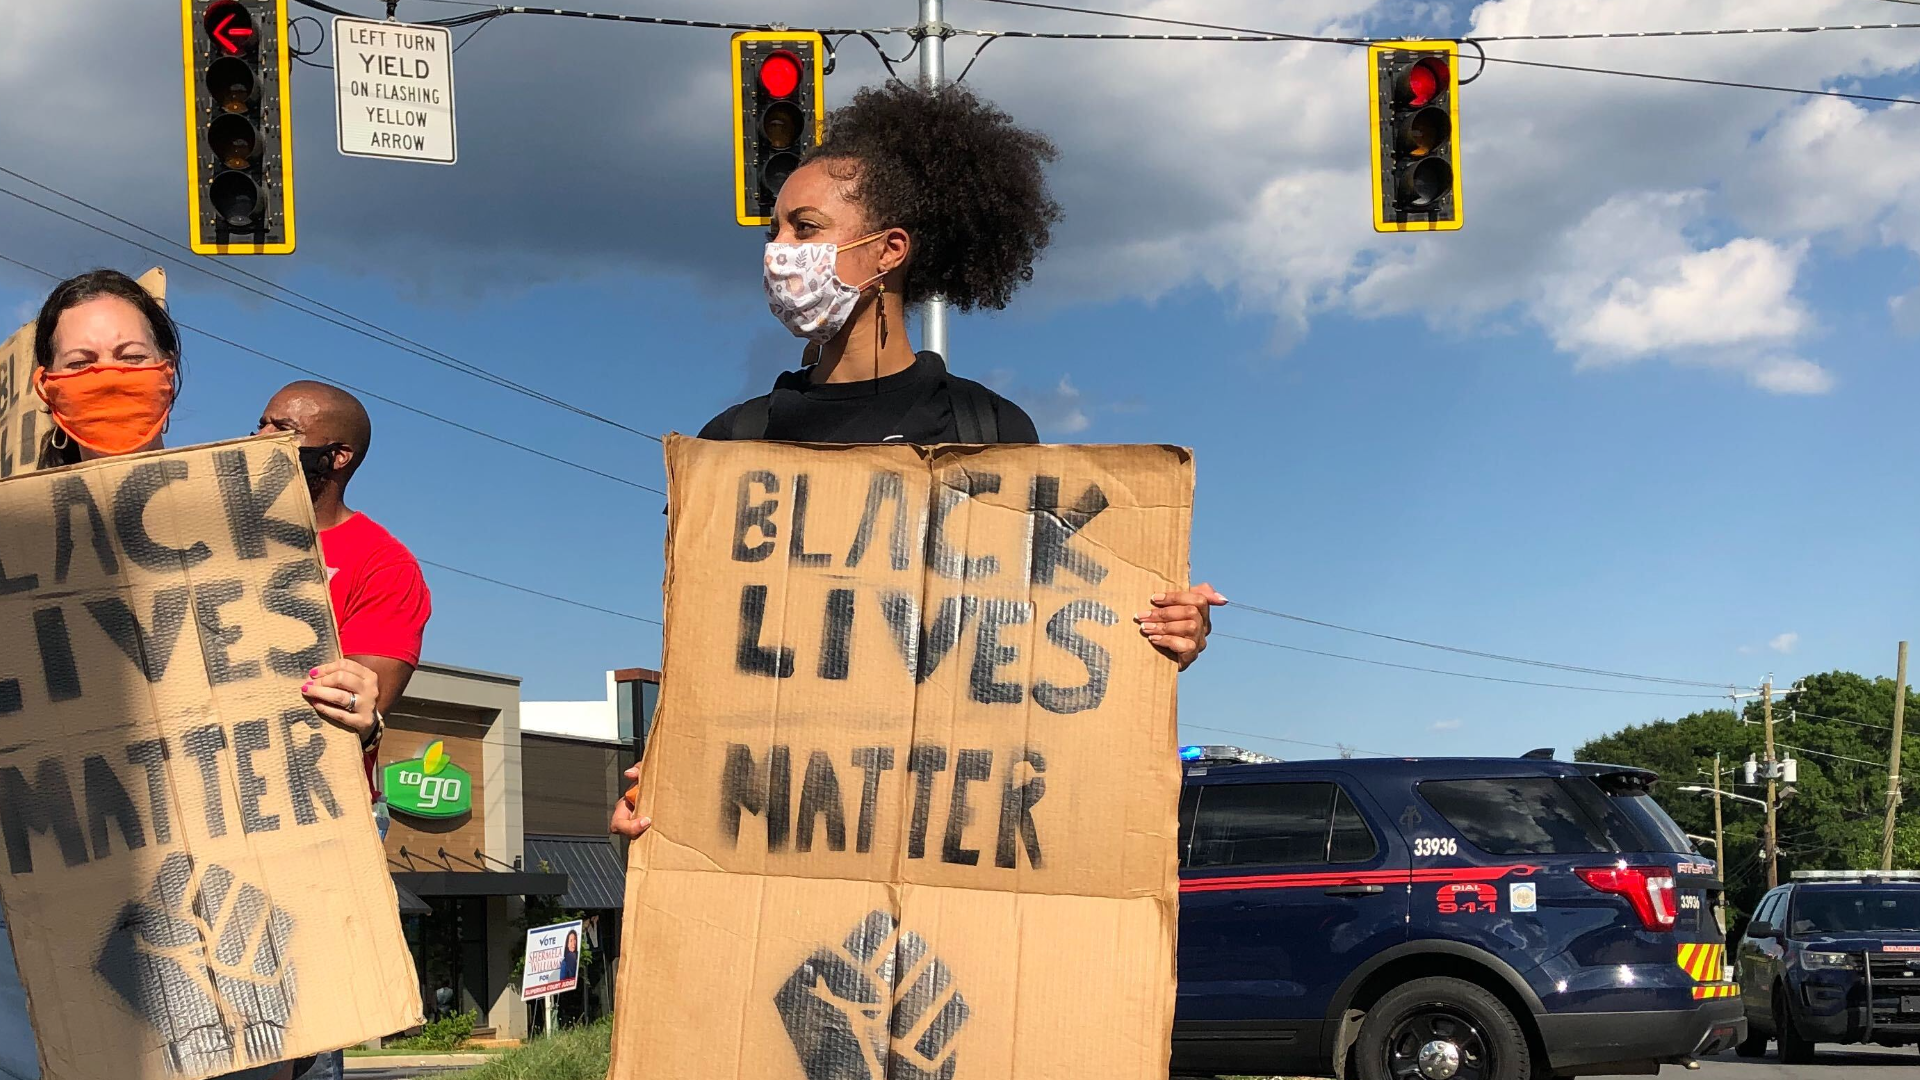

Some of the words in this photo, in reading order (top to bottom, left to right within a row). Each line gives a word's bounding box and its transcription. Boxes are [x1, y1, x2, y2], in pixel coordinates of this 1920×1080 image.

[350, 28, 386, 46] LEFT
[395, 33, 435, 51] TURN
[359, 53, 430, 79] YIELD
[351, 81, 368, 97] ON
[376, 83, 440, 104] FLASHING
[366, 106, 427, 127] YELLOW
[371, 132, 424, 151] ARROW
[732, 470, 1110, 586] BLACK
[0, 559, 334, 712] IVES
[735, 584, 1119, 714] LIVES
[0, 708, 344, 874] MATTER
[720, 743, 1047, 870] MATTER
[1414, 838, 1457, 856] 33936
[1451, 884, 1481, 892] DIAL
[1681, 894, 1700, 909] 33936
[539, 933, 556, 946] VOTE
[525, 986, 546, 996] SUPERIOR
[547, 982, 561, 991] COURT
[562, 980, 575, 988] JUDGE
[539, 974, 549, 982] FOR
